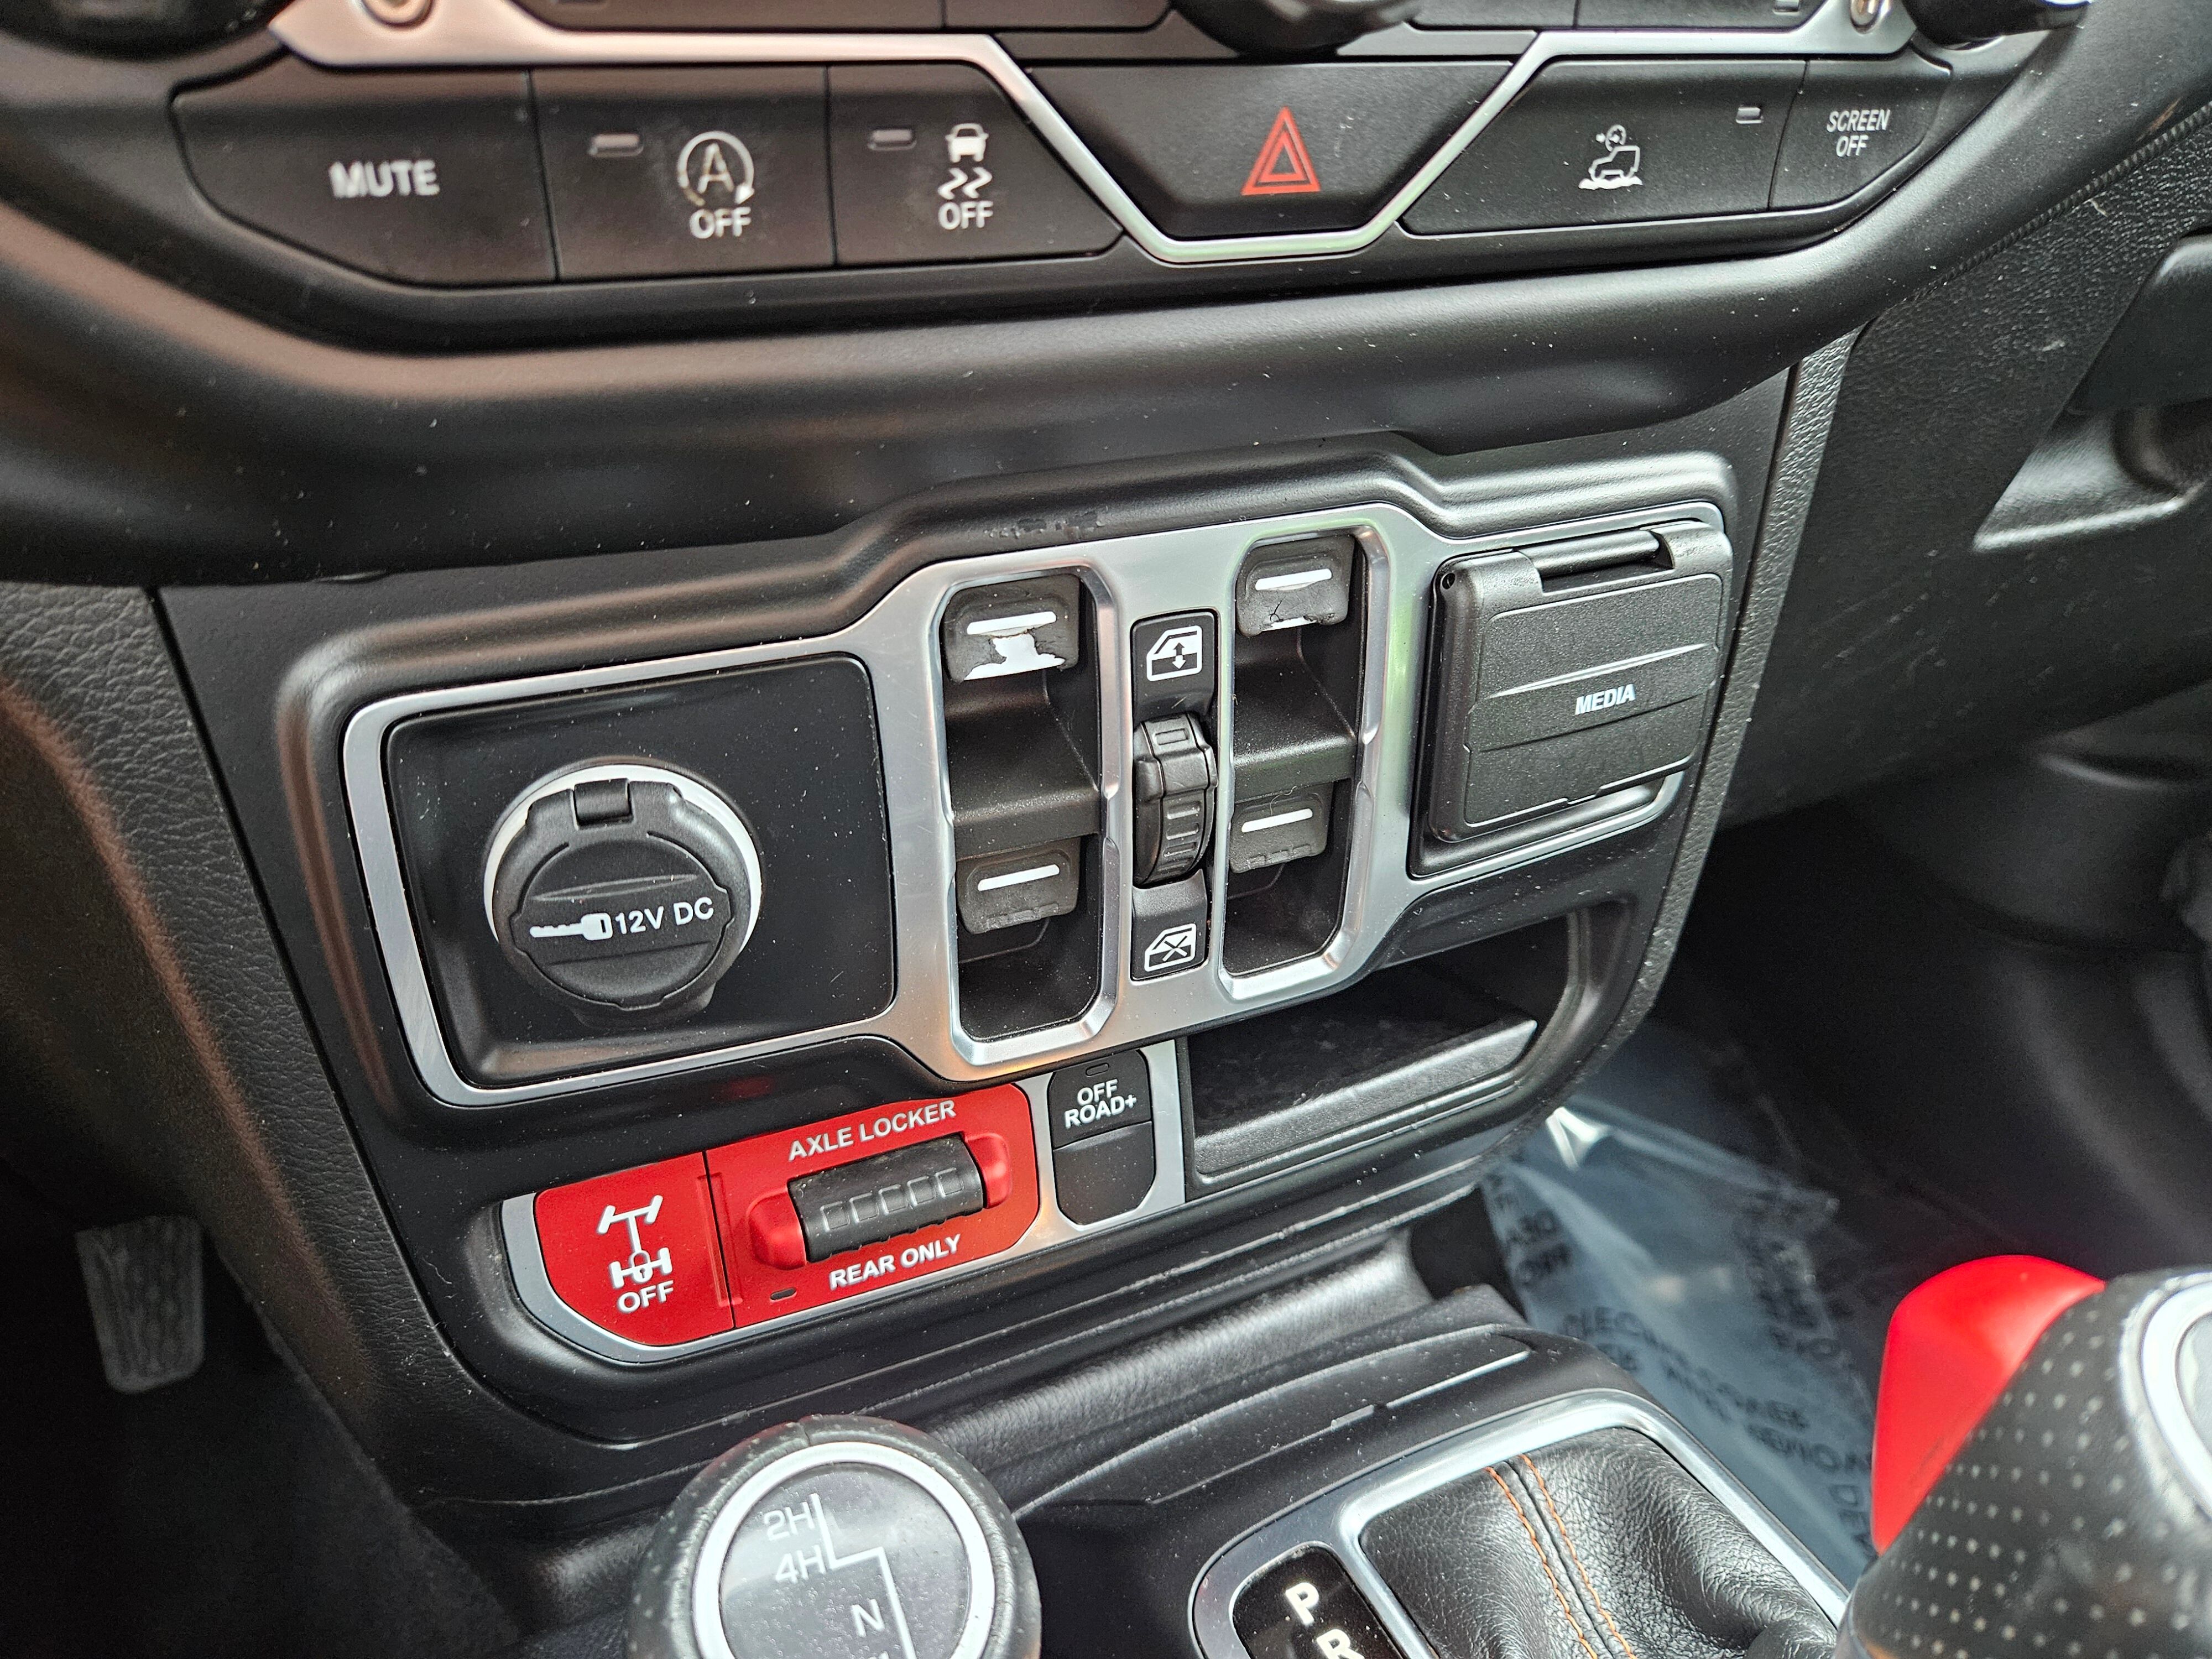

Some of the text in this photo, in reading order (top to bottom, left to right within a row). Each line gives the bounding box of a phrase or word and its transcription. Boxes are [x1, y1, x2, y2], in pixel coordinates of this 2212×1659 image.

[1827, 109, 1890, 133] SCREEN
[1836, 135, 1869, 157] OFF
[329, 159, 440, 199] MUTE
[689, 206, 752, 239] OFF
[938, 200, 994, 229] OFF
[1575, 684, 1636, 715] MEDIA
[615, 896, 714, 935] 12V DC
[1077, 1078, 1118, 1107] OFF
[1065, 1094, 1137, 1129] ROAD+
[789, 1099, 957, 1162] AXLE LOCKER
[830, 1234, 961, 1291] REAR ONLY
[617, 1279, 674, 1314] OFF
[764, 1501, 815, 1541] 2H
[775, 1545, 827, 1584] 4H
[851, 1598, 884, 1637] N
[1285, 1582, 1319, 1626] P
[1316, 1628, 1366, 1659] R
